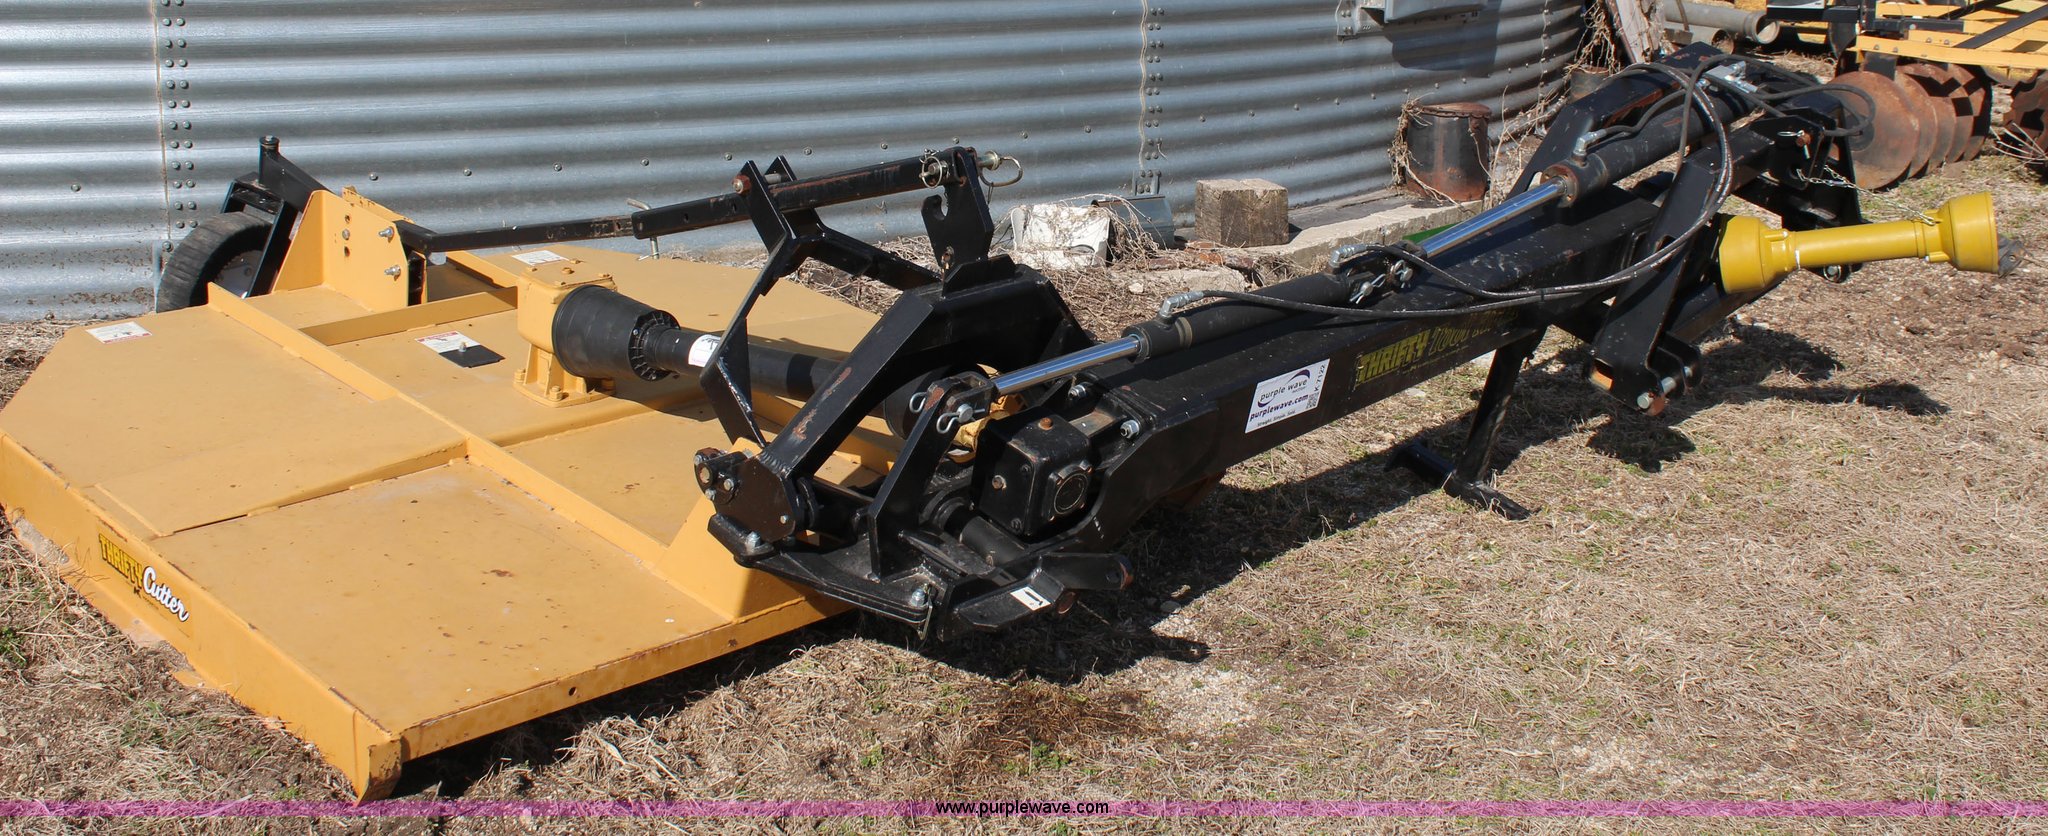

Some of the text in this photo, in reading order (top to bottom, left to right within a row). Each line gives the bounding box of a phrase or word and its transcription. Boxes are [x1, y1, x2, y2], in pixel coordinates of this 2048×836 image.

[1356, 329, 1431, 384] THRIFTY
[1249, 394, 1309, 421] purplewave.com
[1260, 379, 1308, 402] purple wave
[98, 533, 143, 590] THRIFTY
[142, 565, 190, 622] Cutter
